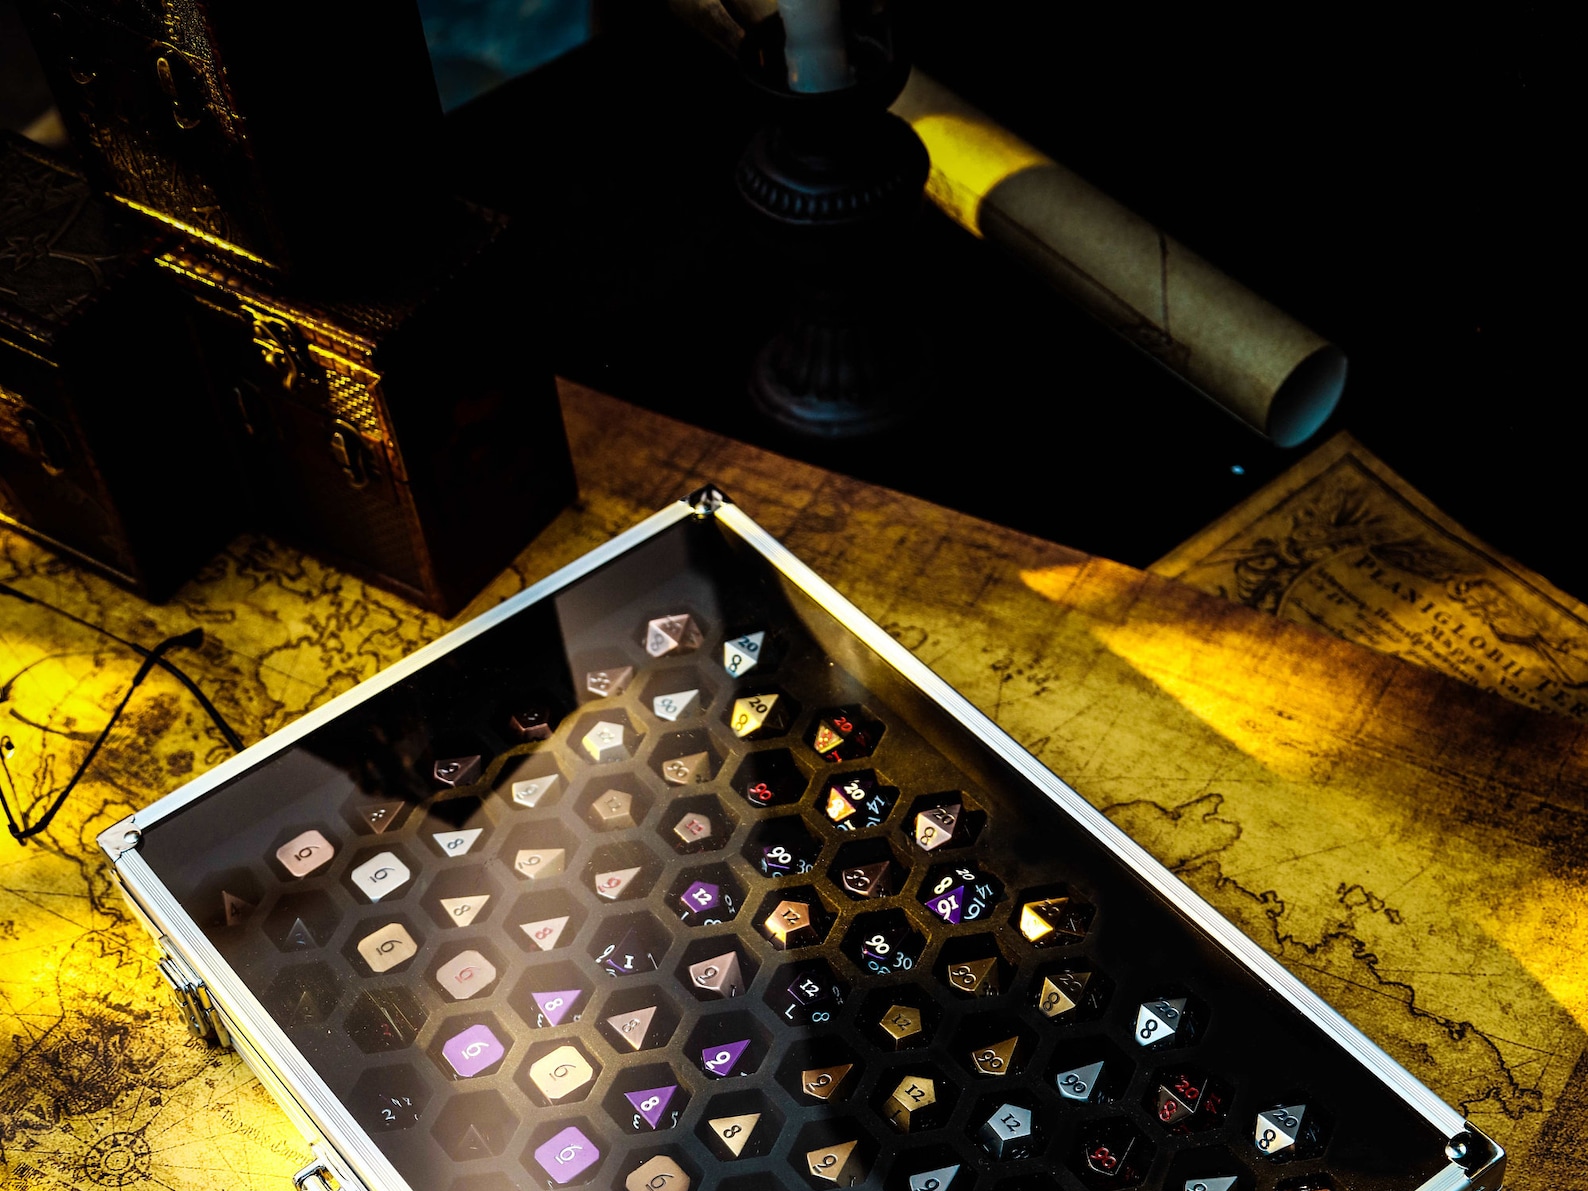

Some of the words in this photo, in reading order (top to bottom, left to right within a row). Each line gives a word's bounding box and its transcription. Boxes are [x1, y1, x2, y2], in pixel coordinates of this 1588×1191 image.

[1354, 554, 1525, 680] PLANIGLOBII
[738, 634, 759, 653] 20
[728, 654, 743, 673] 8
[749, 695, 768, 714] 20
[735, 713, 749, 732] 8
[834, 716, 853, 733] 20
[749, 783, 772, 800] 90
[843, 782, 866, 801] 20
[932, 807, 955, 825] 20
[447, 838, 465, 850] 8
[920, 826, 935, 846] 8
[294, 845, 320, 861] 6
[767, 846, 792, 864] 90
[369, 867, 395, 883] 6
[955, 868, 976, 881] 20
[934, 876, 953, 895] 8
[691, 888, 712, 906] 12
[453, 904, 472, 917] 8
[782, 909, 800, 925] 12
[535, 927, 553, 940] 8
[376, 940, 403, 956] 6
[865, 934, 890, 955] 90
[893, 951, 913, 970] 30
[455, 967, 481, 984] 6
[800, 979, 820, 997] 12
[544, 998, 564, 1011] 8
[1043, 991, 1061, 1012] 8
[812, 1011, 830, 1023] 8
[1140, 1019, 1159, 1039] 8
[461, 1042, 490, 1060] 6
[706, 1051, 731, 1070] 9
[549, 1064, 577, 1081] 6
[1061, 1073, 1087, 1094] 90
[1175, 1079, 1200, 1099] 20
[904, 1084, 925, 1102] 12
[640, 1096, 660, 1112] 8
[1159, 1100, 1178, 1122] 8
[1000, 1113, 1021, 1133] 12
[1273, 1109, 1299, 1129] 20
[723, 1124, 742, 1139] 8
[1258, 1129, 1277, 1150] 8
[555, 1145, 583, 1164] 6
[813, 1153, 838, 1173] 9
[1090, 1147, 1117, 1169] 90
